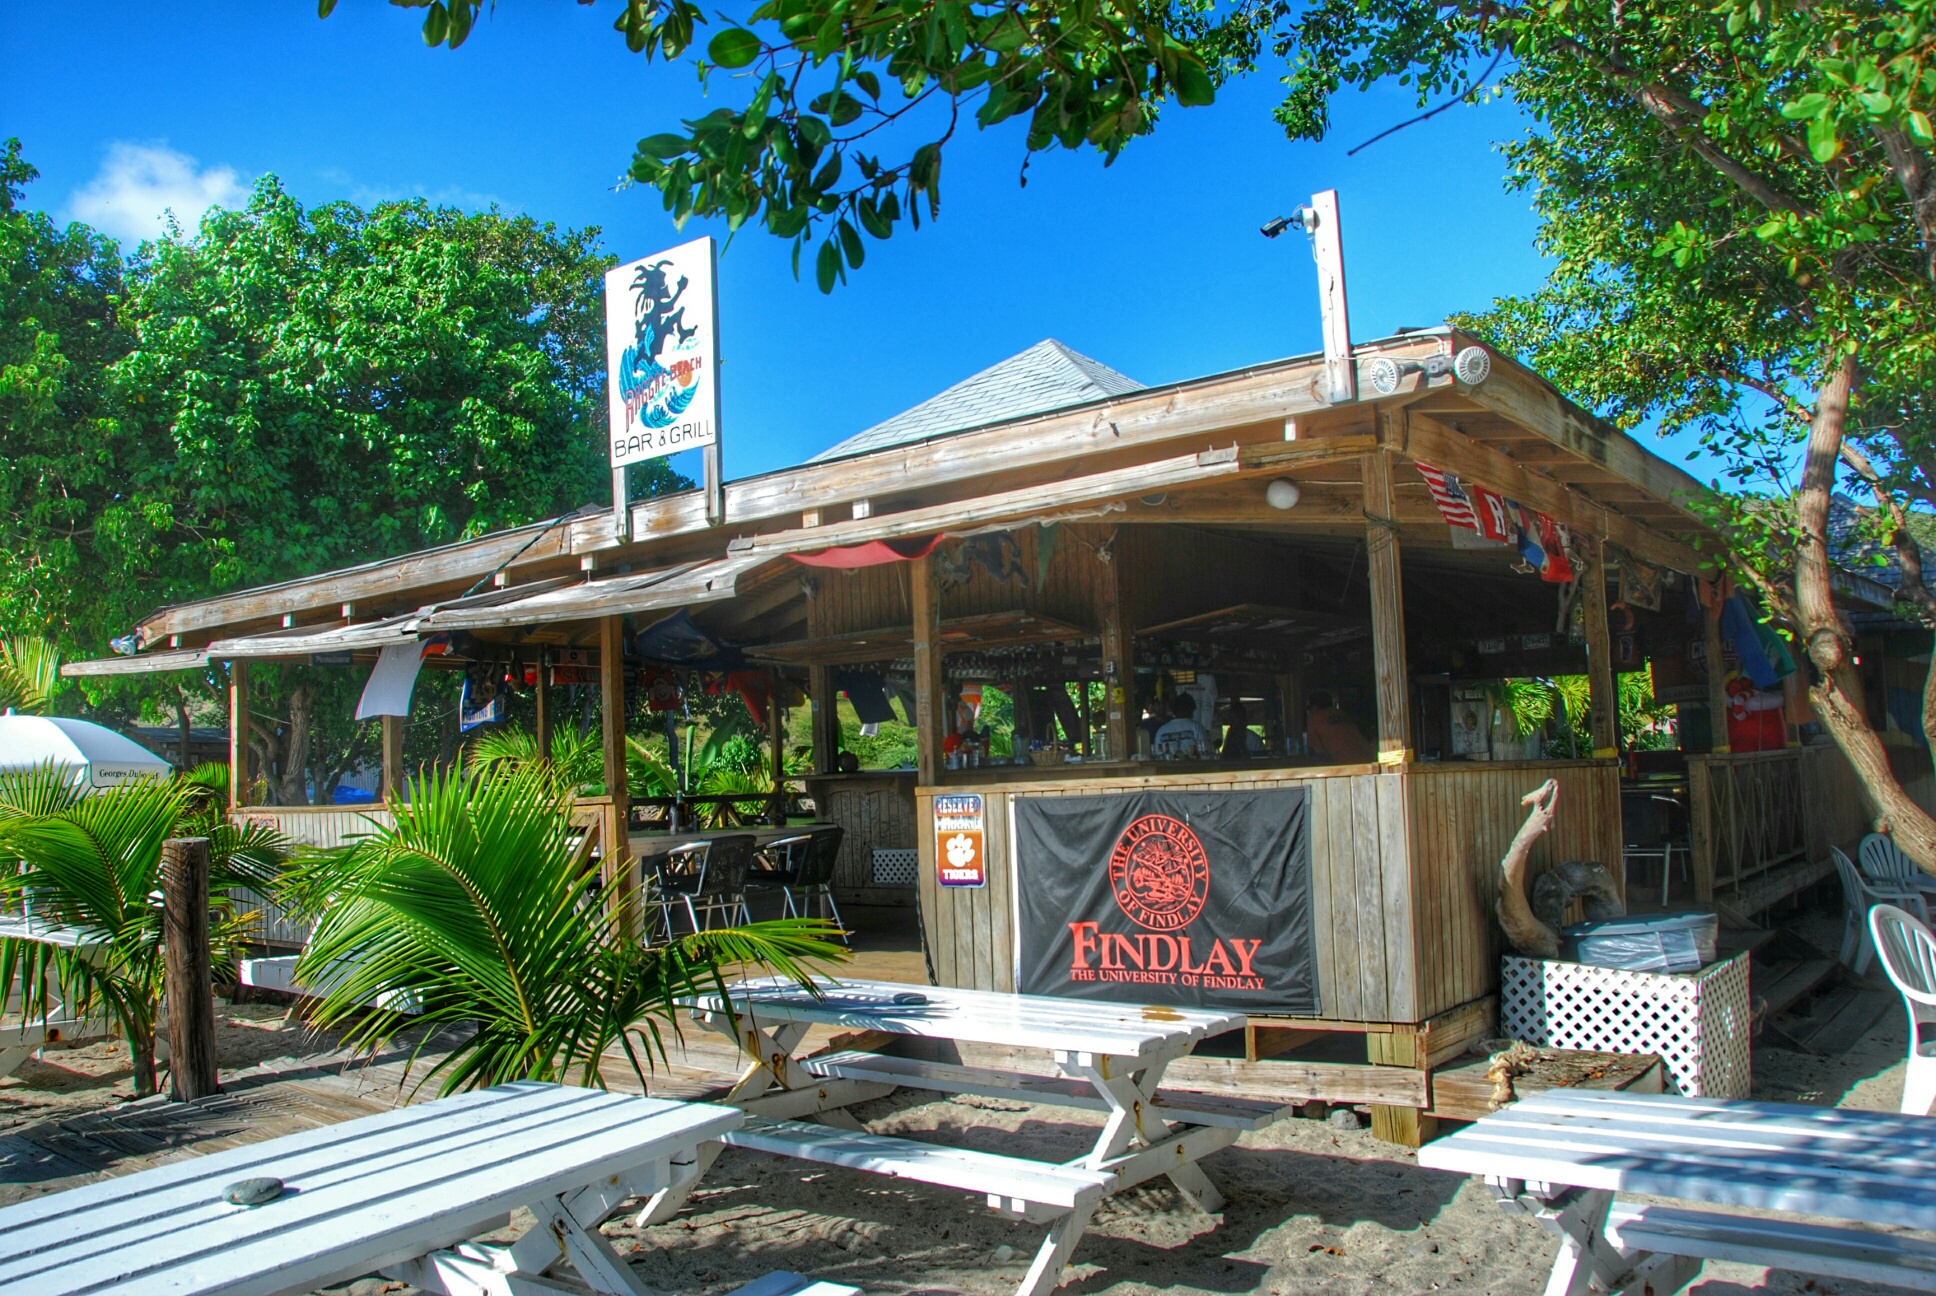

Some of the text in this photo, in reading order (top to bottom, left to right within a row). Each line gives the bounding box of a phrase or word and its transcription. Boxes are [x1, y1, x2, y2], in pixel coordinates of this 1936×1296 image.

[670, 356, 702, 381] BEACH
[614, 420, 713, 458] BAR & GRILL
[99, 769, 127, 778] Georges
[1112, 818, 1207, 882] THE UNIVERSITY
[1119, 890, 1139, 912] OF
[1139, 891, 1202, 928] FINDLAY
[1068, 921, 1262, 976] FINDLAY
[1070, 969, 1096, 981] THE
[1099, 970, 1178, 985] UNIVERSITY
[1181, 974, 1199, 987] OF
